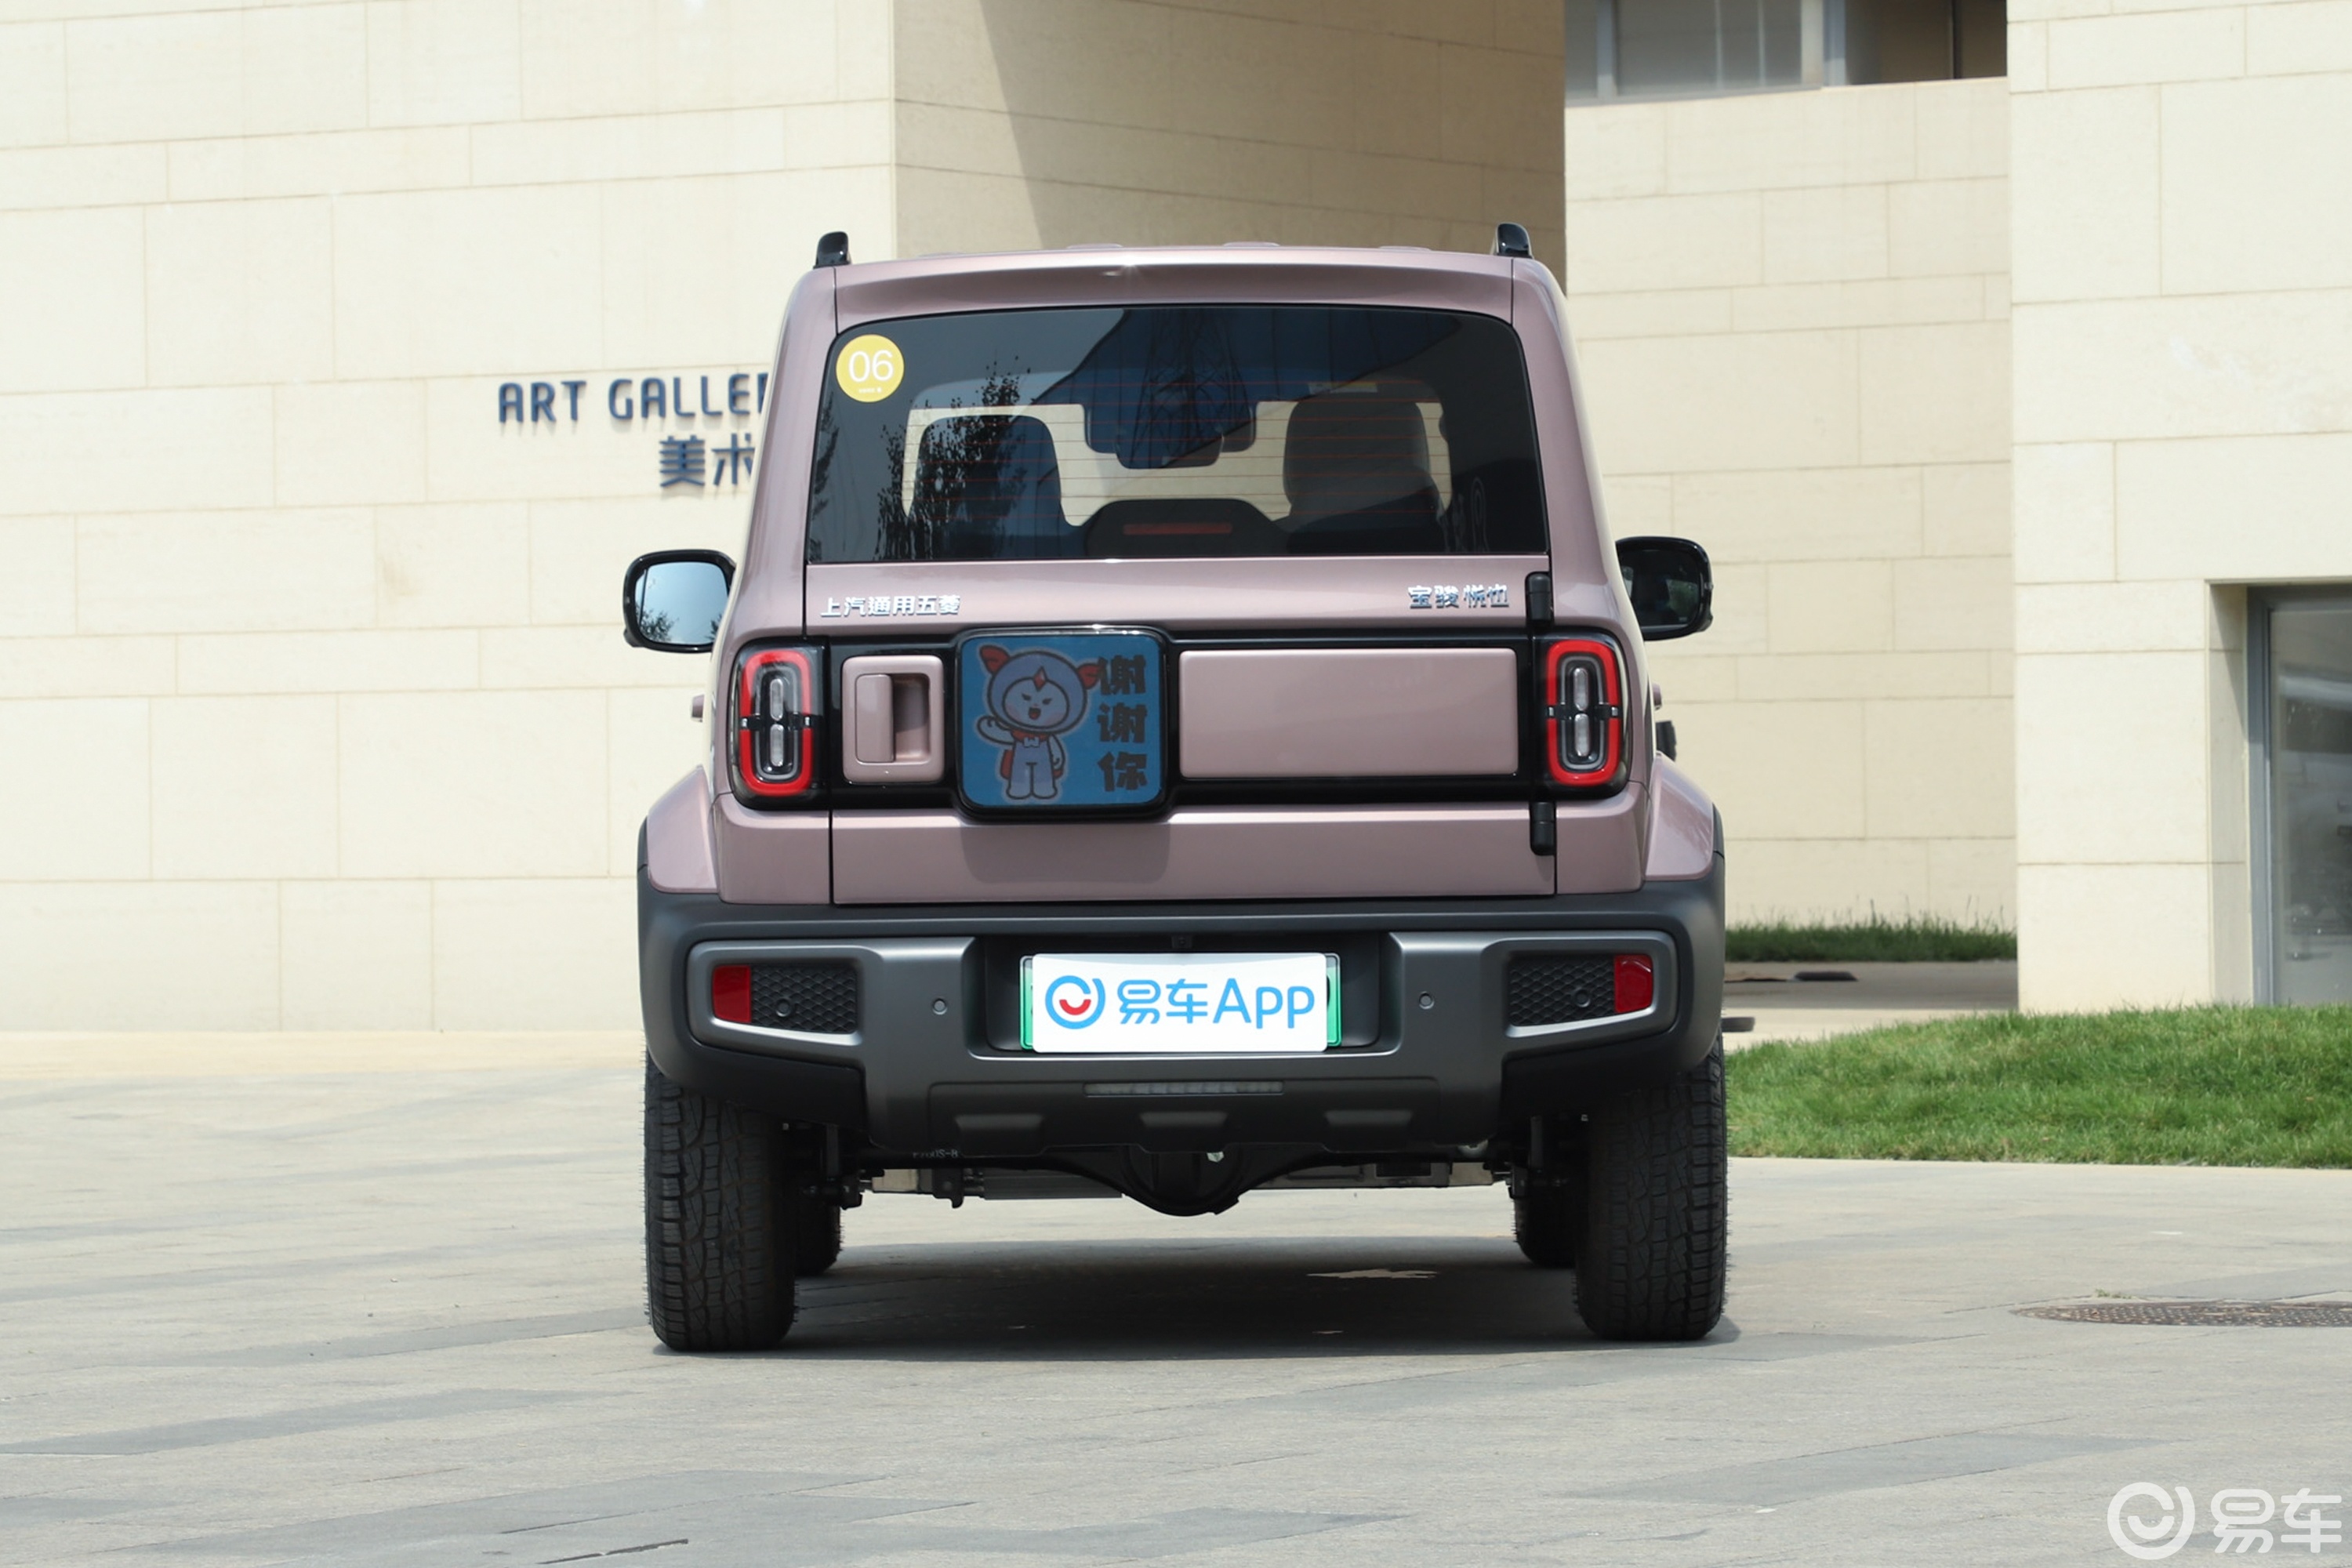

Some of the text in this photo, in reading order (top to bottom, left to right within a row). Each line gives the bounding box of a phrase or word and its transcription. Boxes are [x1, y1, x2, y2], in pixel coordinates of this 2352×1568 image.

[849, 350, 894, 383] 06
[499, 380, 587, 423] ART
[820, 594, 961, 618] 上汽通用五菱
[1098, 655, 1148, 792] 谢谢你
